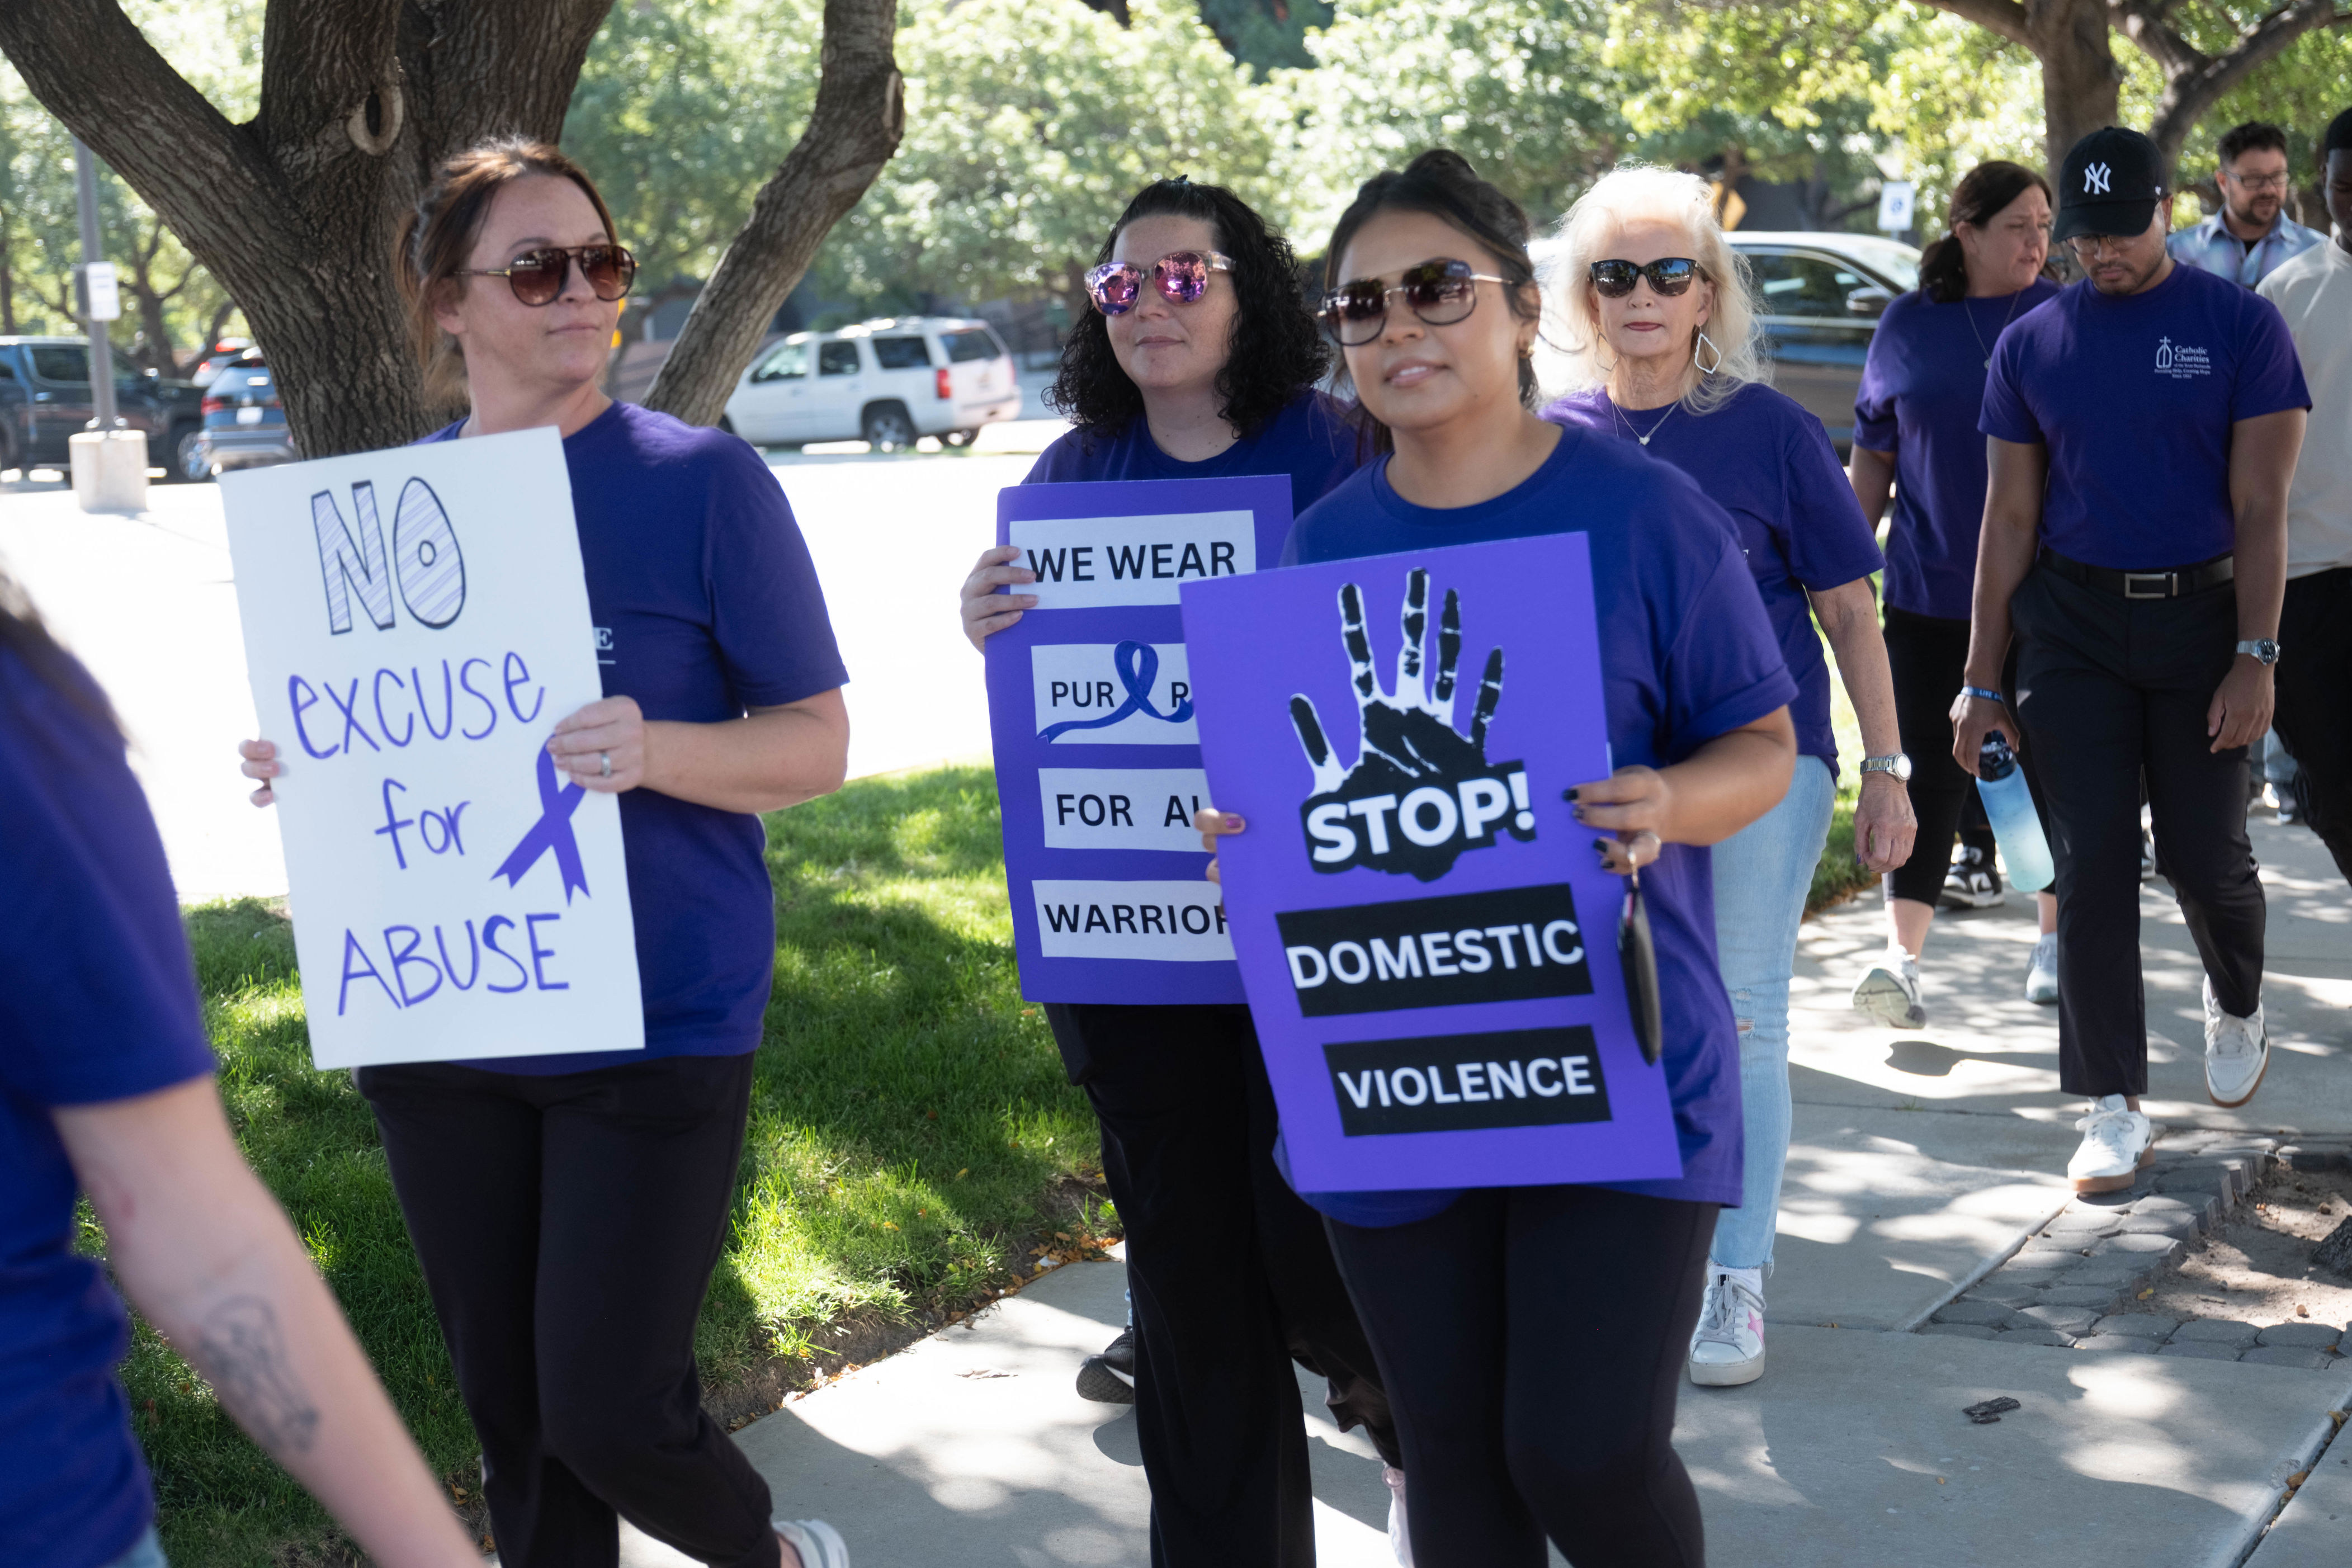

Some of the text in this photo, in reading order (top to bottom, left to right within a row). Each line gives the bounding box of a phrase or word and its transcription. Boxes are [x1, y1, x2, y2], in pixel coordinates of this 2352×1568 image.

[2084, 161, 2112, 195] NY
[2174, 345, 2208, 355] Catholic
[2174, 353, 2209, 363] Charities
[311, 476, 466, 635] NO
[1027, 541, 1236, 583] WE WEAR
[287, 651, 545, 760] excuse
[374, 777, 472, 870] for
[1056, 794, 1134, 827] FOR
[1306, 771, 1536, 865] STOP!
[337, 911, 570, 1017] ABUSE
[1285, 918, 1585, 990] DOMESTIC
[1337, 1054, 1596, 1109] VIOLENCE
